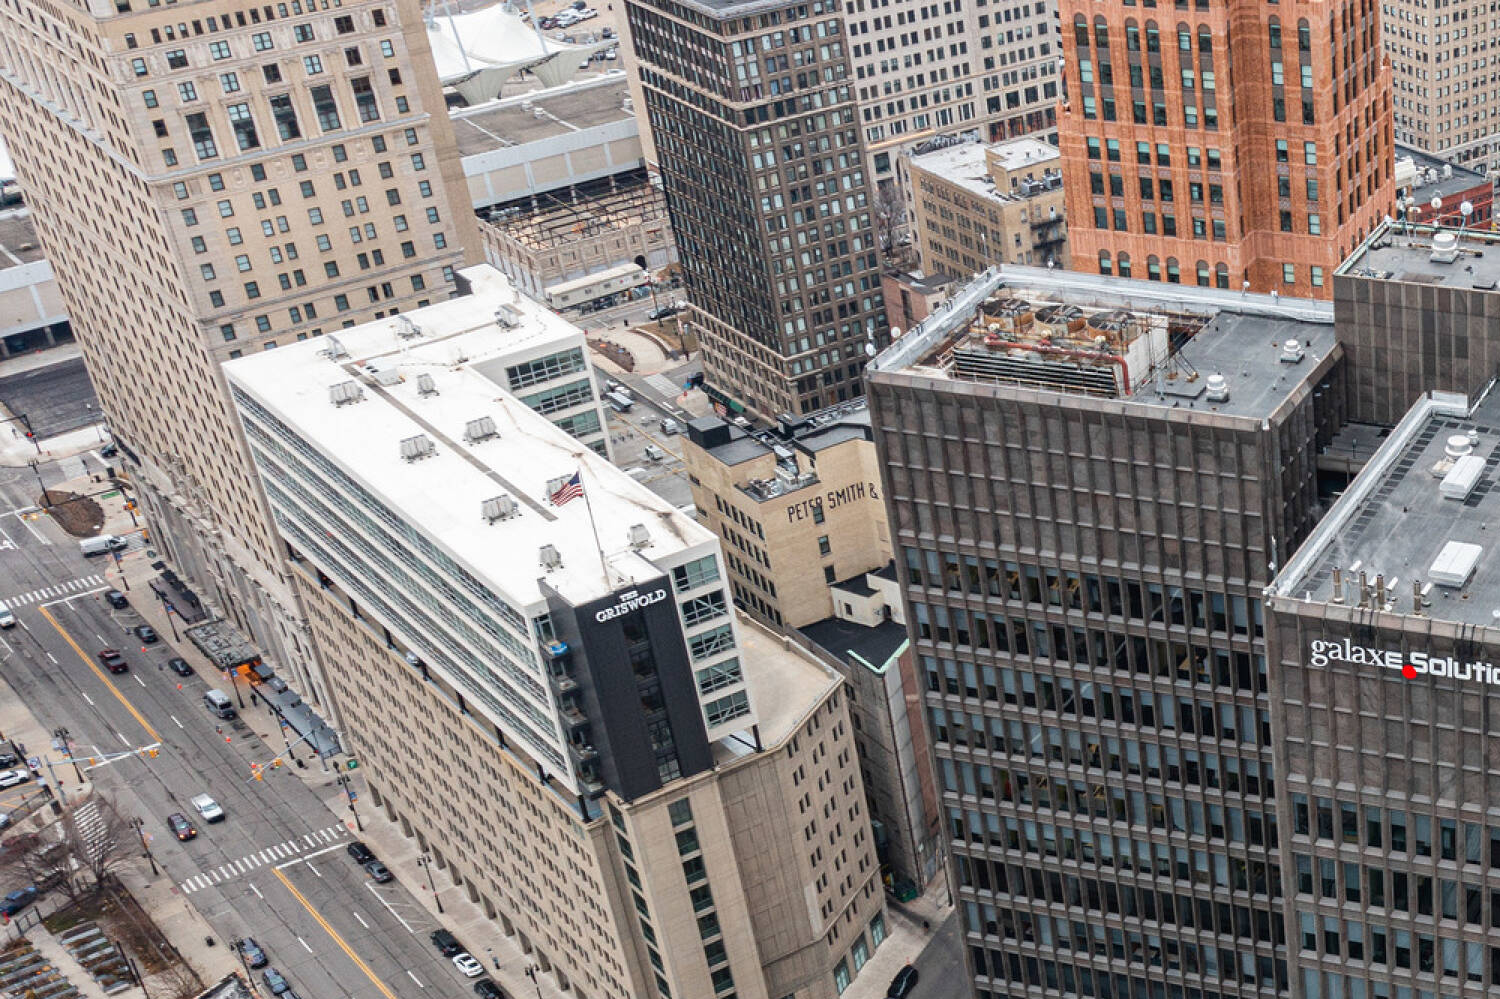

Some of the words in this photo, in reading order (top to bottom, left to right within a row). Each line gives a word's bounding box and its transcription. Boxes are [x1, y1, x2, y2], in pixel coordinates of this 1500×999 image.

[827, 481, 865, 509] SMITH
[868, 482, 879, 500] &
[596, 589, 667, 623] GRISWOLD
